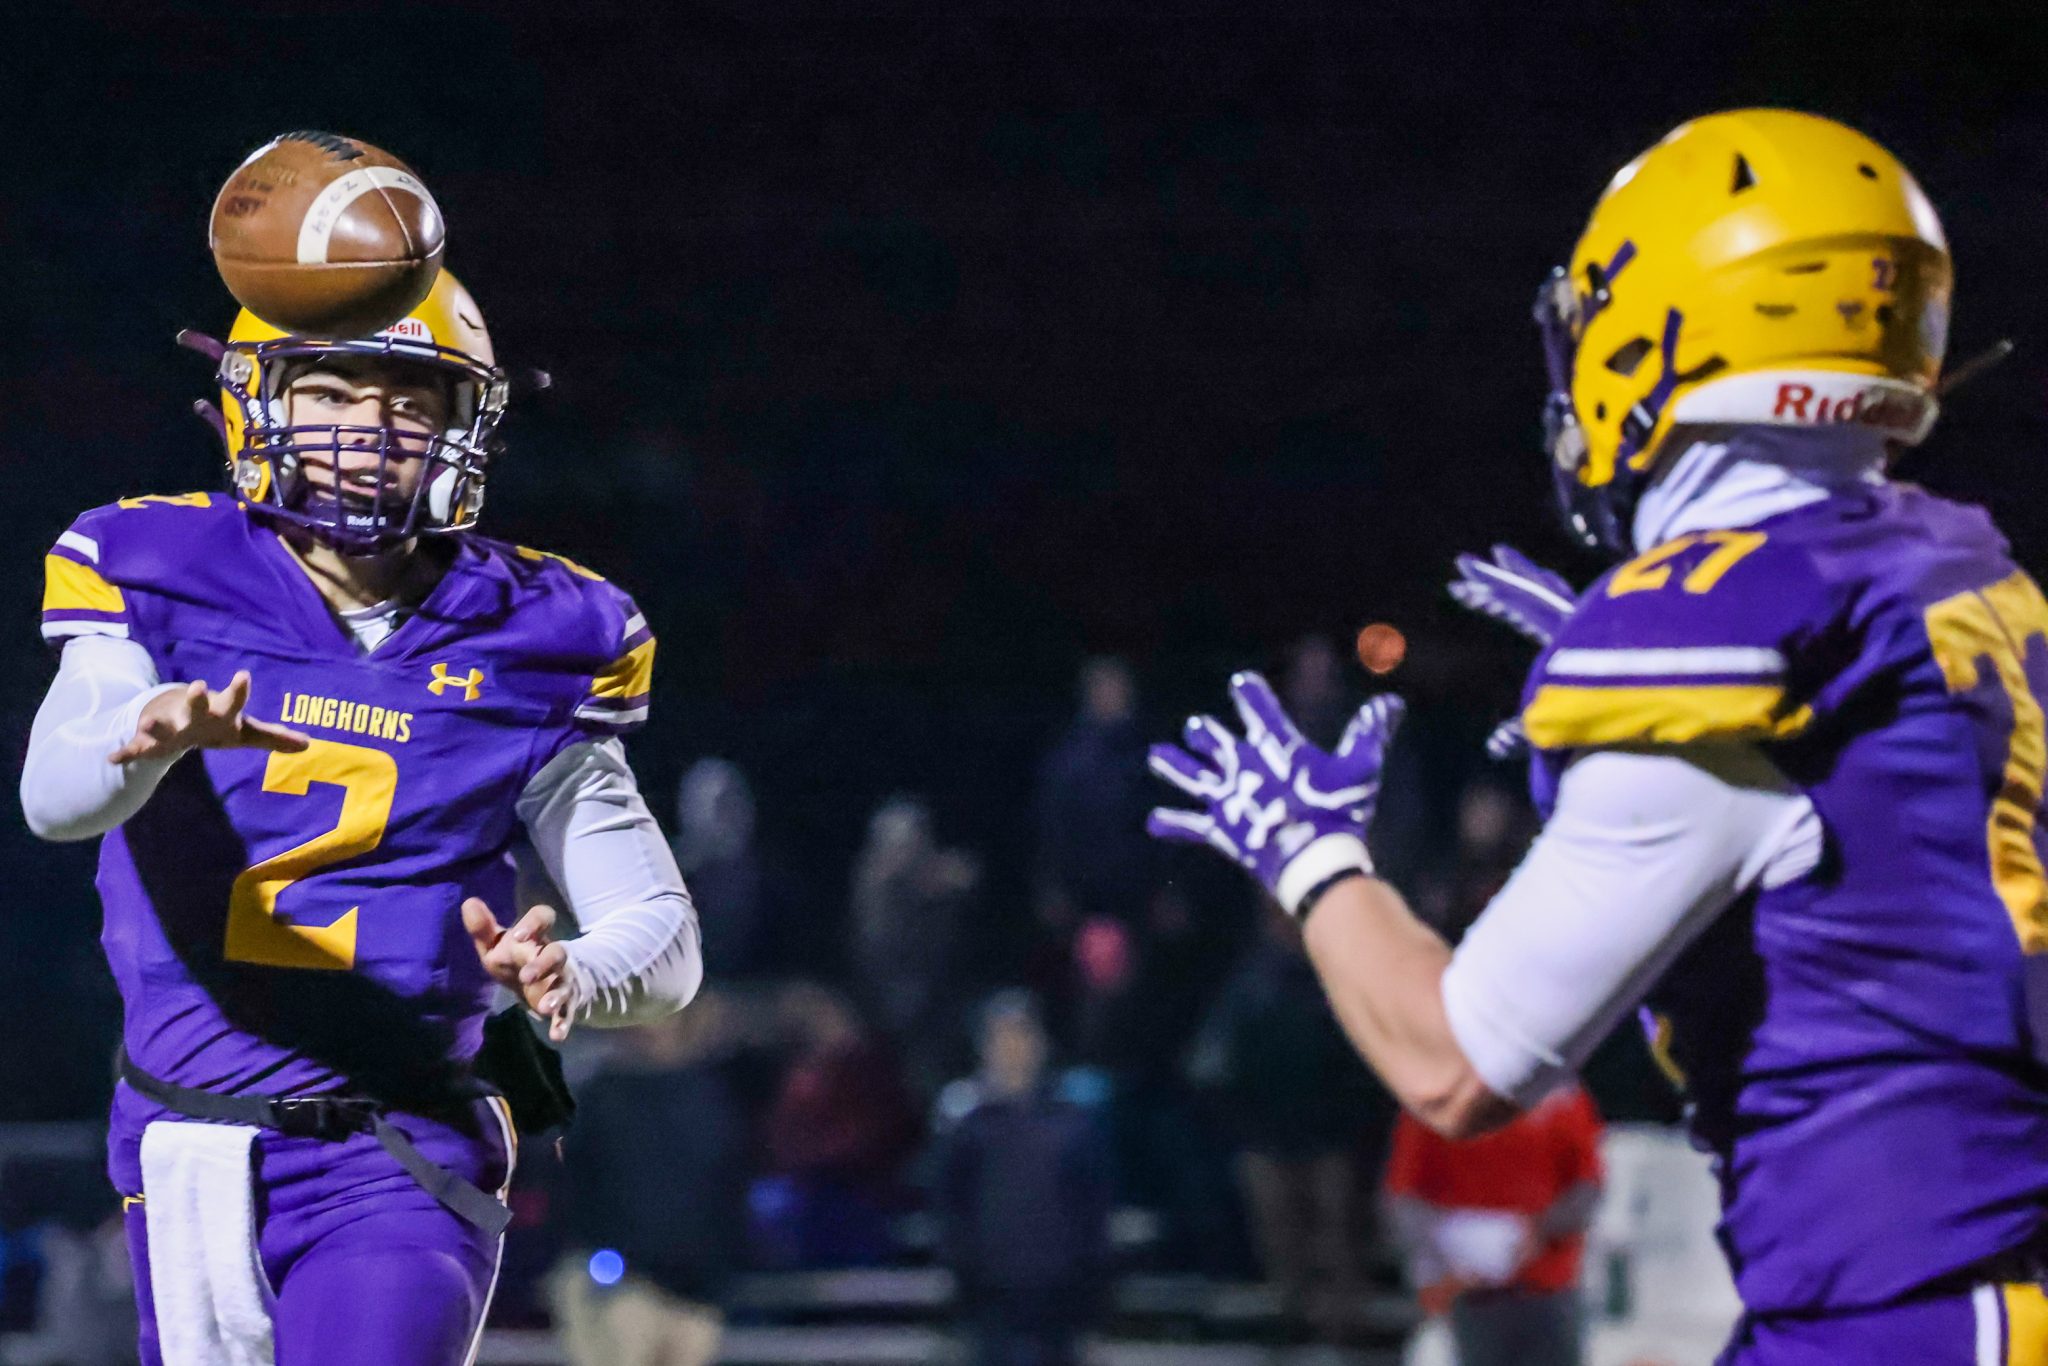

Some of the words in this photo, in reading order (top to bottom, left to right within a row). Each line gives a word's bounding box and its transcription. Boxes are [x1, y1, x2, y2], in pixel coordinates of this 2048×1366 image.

[385, 322, 422, 336] dell
[346, 515, 387, 527] Riddll
[1606, 529, 1769, 599] 27
[280, 692, 414, 743] LONGHORNS
[223, 738, 399, 970] 2
